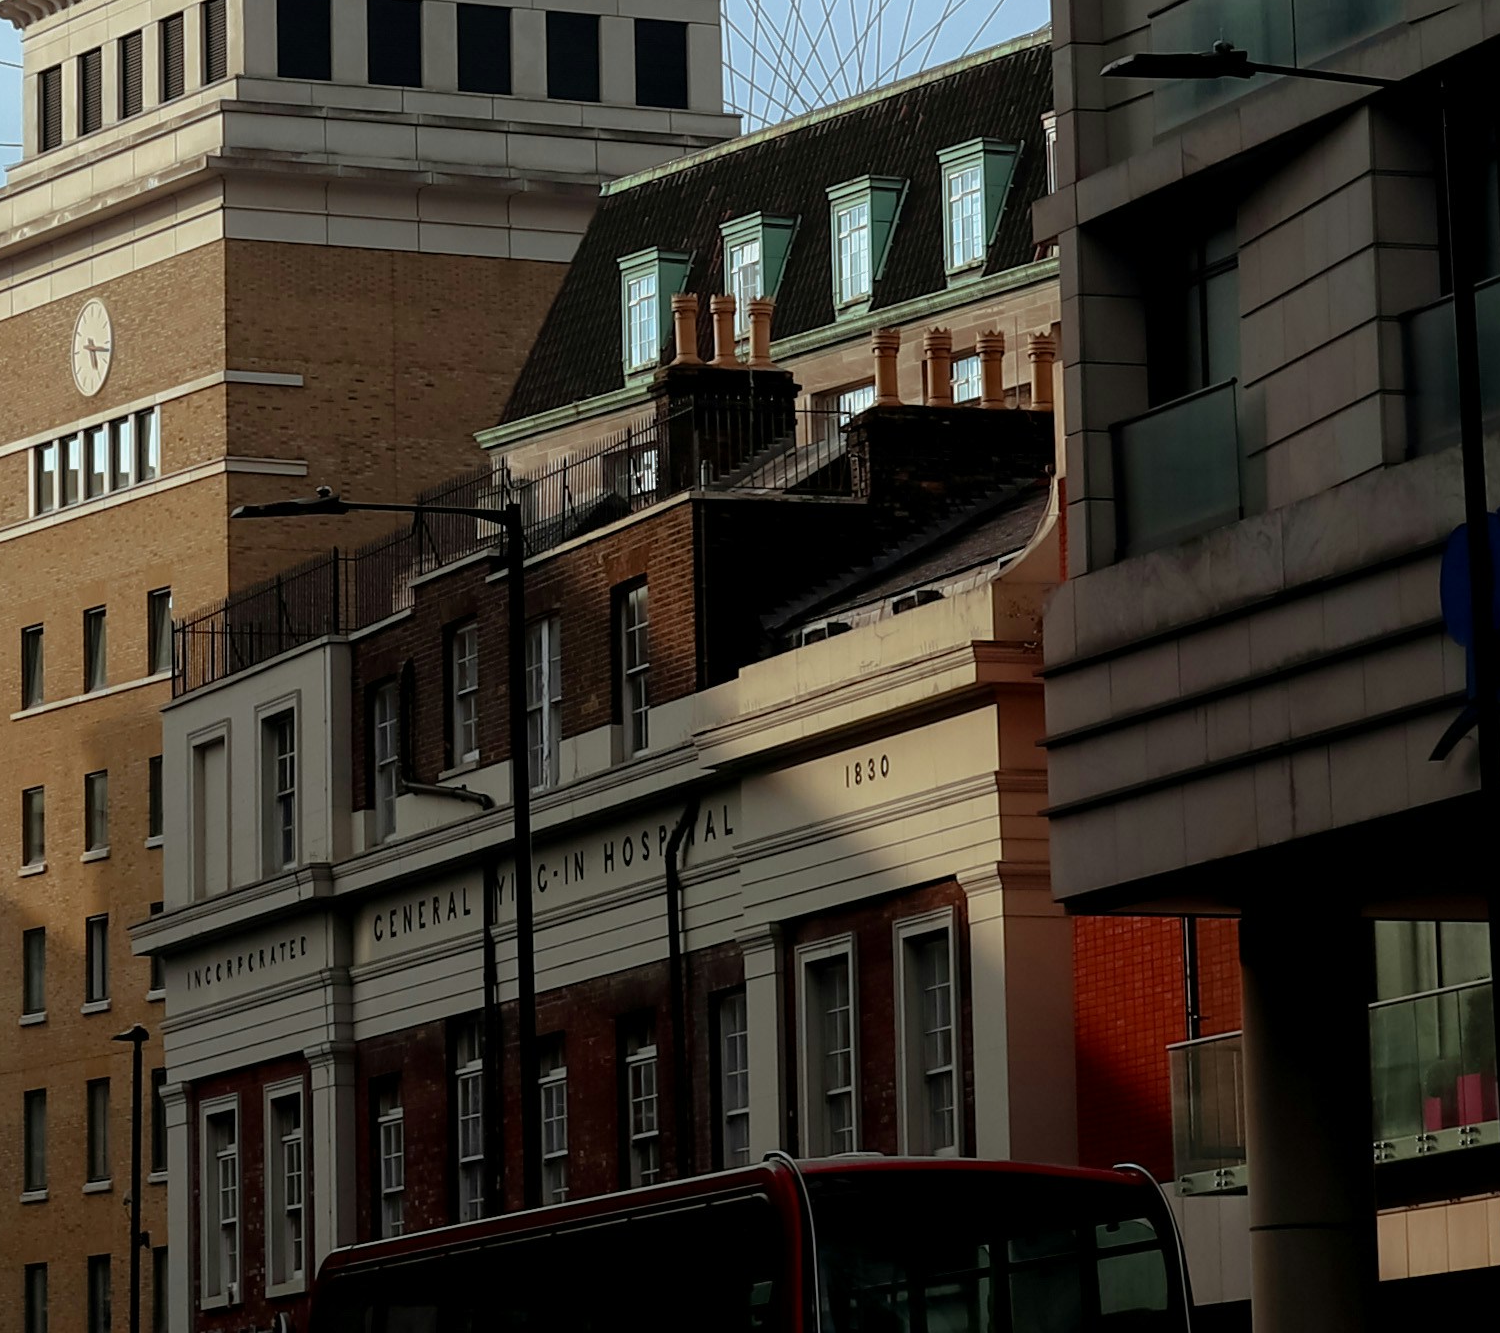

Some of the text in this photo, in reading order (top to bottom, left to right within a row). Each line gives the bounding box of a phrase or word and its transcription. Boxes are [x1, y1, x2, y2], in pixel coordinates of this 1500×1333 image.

[845, 754, 889, 788] 1830
[374, 888, 471, 941] GENERAL
[187, 935, 307, 991] INCORPORATED
